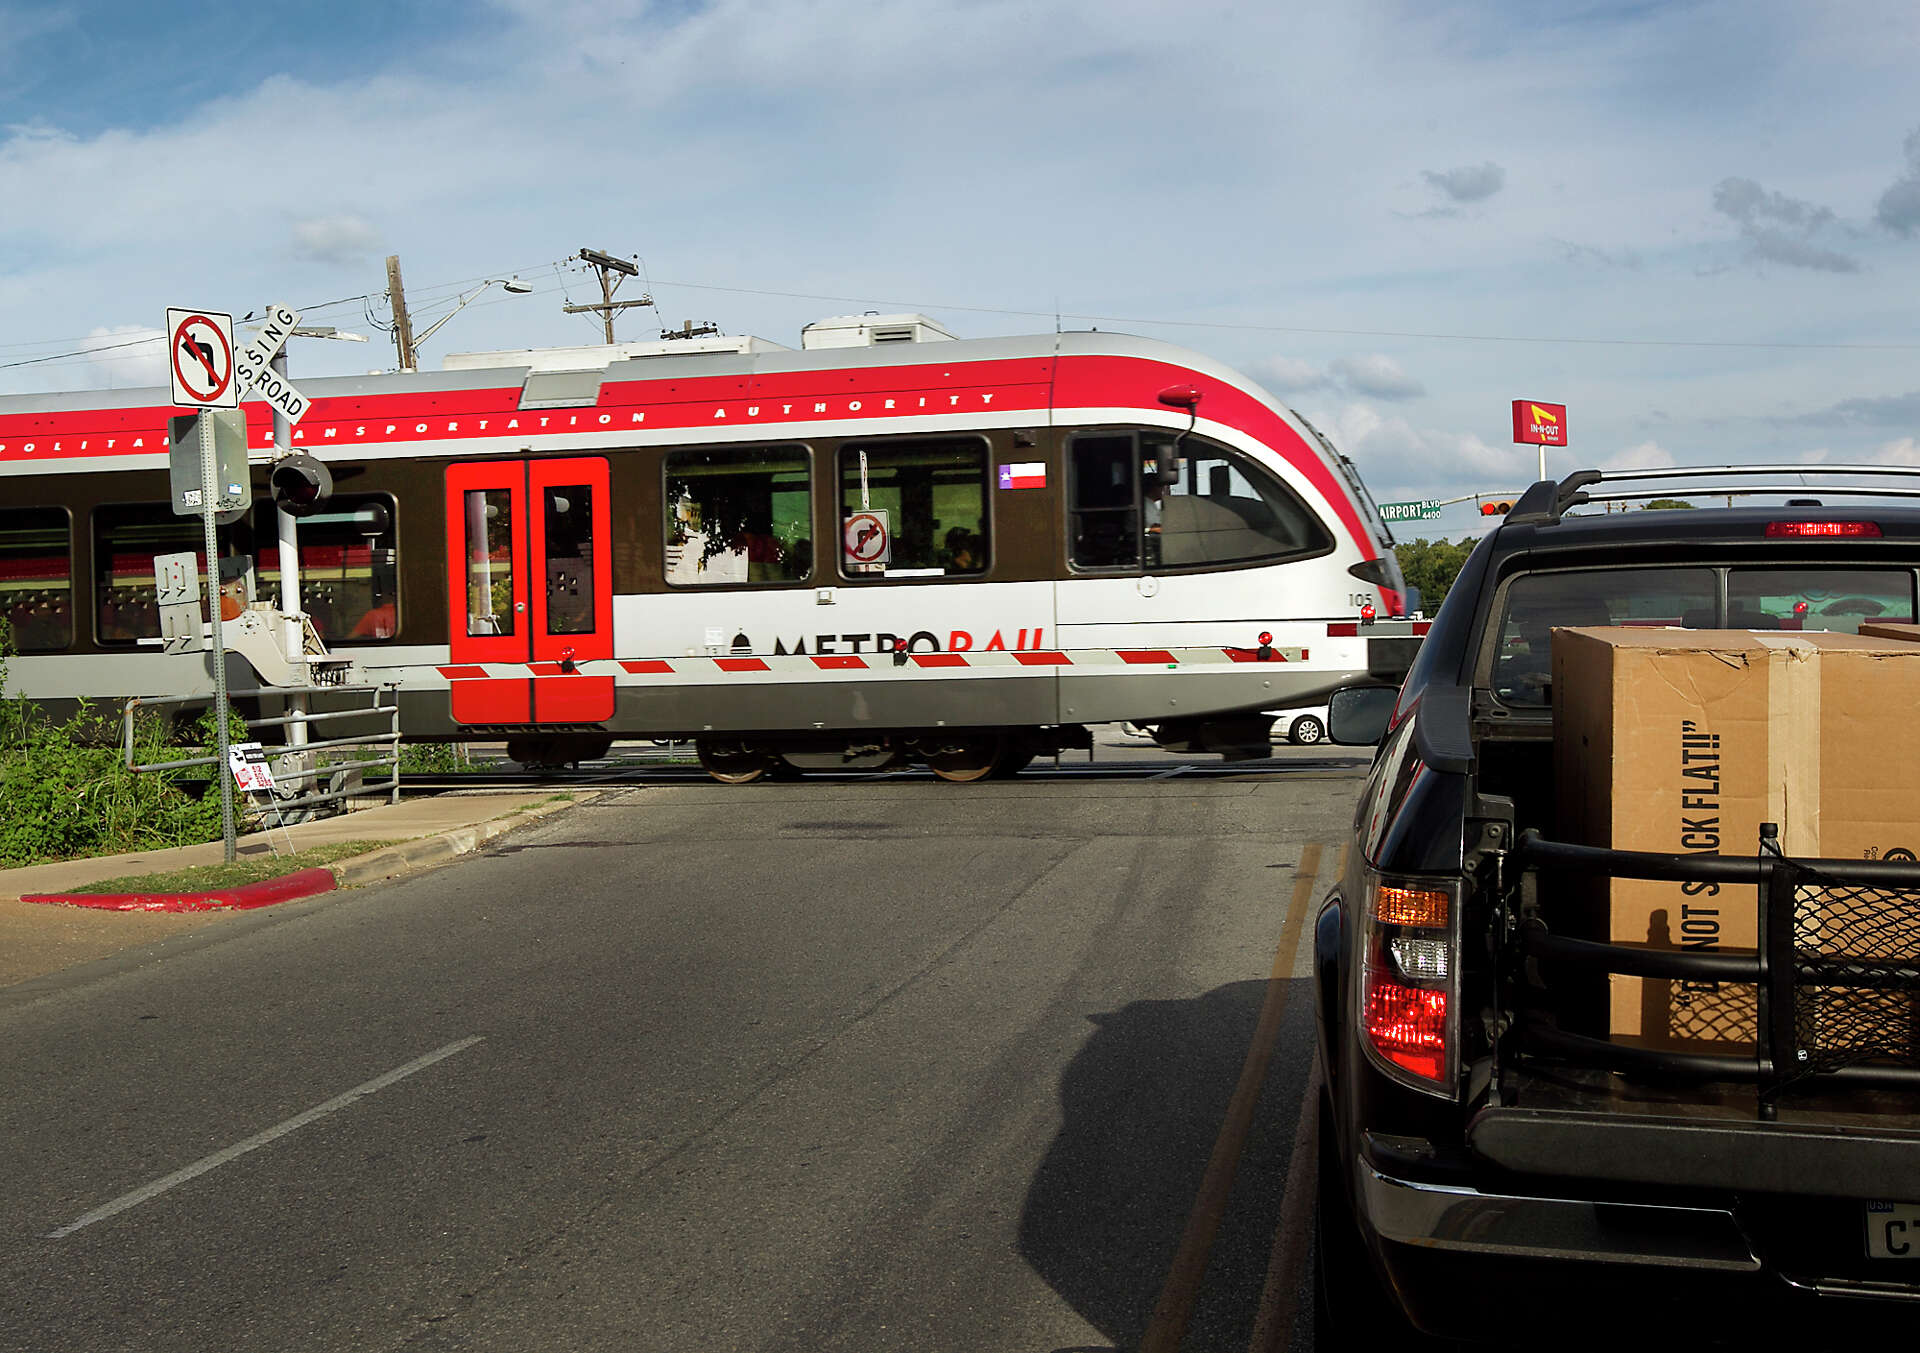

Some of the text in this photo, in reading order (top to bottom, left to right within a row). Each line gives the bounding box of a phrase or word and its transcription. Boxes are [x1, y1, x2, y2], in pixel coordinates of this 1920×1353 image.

[237, 310, 293, 394] SSING
[255, 371, 302, 416] ROAD
[264, 412, 646, 441] RANSPORTATION
[714, 393, 994, 418] AUTHORITY
[1531, 424, 1558, 435] IN-N-OUT
[1380, 500, 1440, 519] AIRPORT BLVD
[1423, 511, 1441, 519] 4400
[1349, 594, 1372, 606] 105
[1681, 817, 1720, 896] SCK
[1681, 904, 1720, 952] NOT
[1885, 1220, 1920, 1255] C
